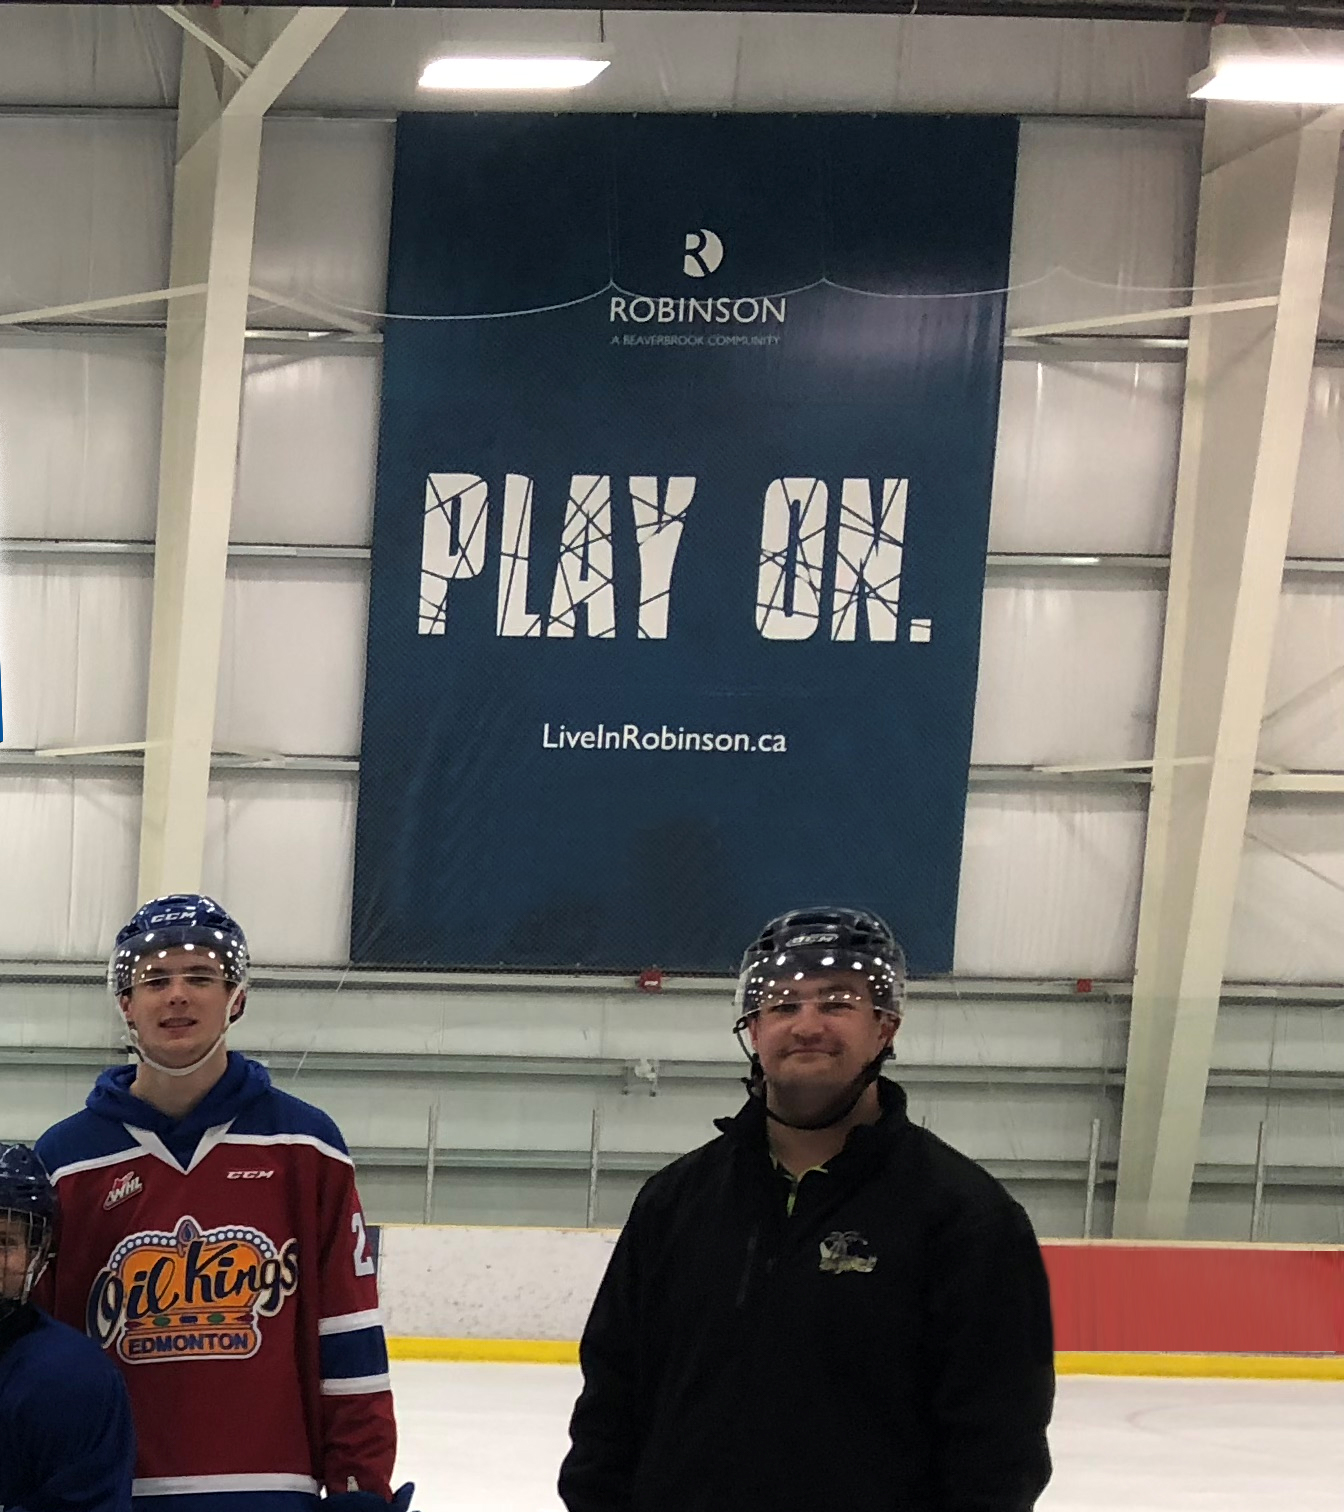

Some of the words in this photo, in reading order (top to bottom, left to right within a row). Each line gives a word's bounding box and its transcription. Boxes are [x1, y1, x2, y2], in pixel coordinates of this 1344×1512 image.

[609, 296, 787, 323] ROBINSON
[611, 334, 620, 345] A
[623, 334, 705, 346] BEAVERBROOK
[707, 334, 780, 346] COMMUNITY
[418, 472, 697, 639] PLAY
[755, 476, 932, 642] ON.
[542, 723, 787, 753] LiveInRobinson.ca
[150, 911, 197, 923] CCM
[226, 1169, 275, 1179] CCM
[107, 1176, 143, 1202] WHL
[87, 1256, 180, 1349] Oil
[183, 1238, 300, 1316] Kings
[128, 1332, 249, 1356] EDMONTON
